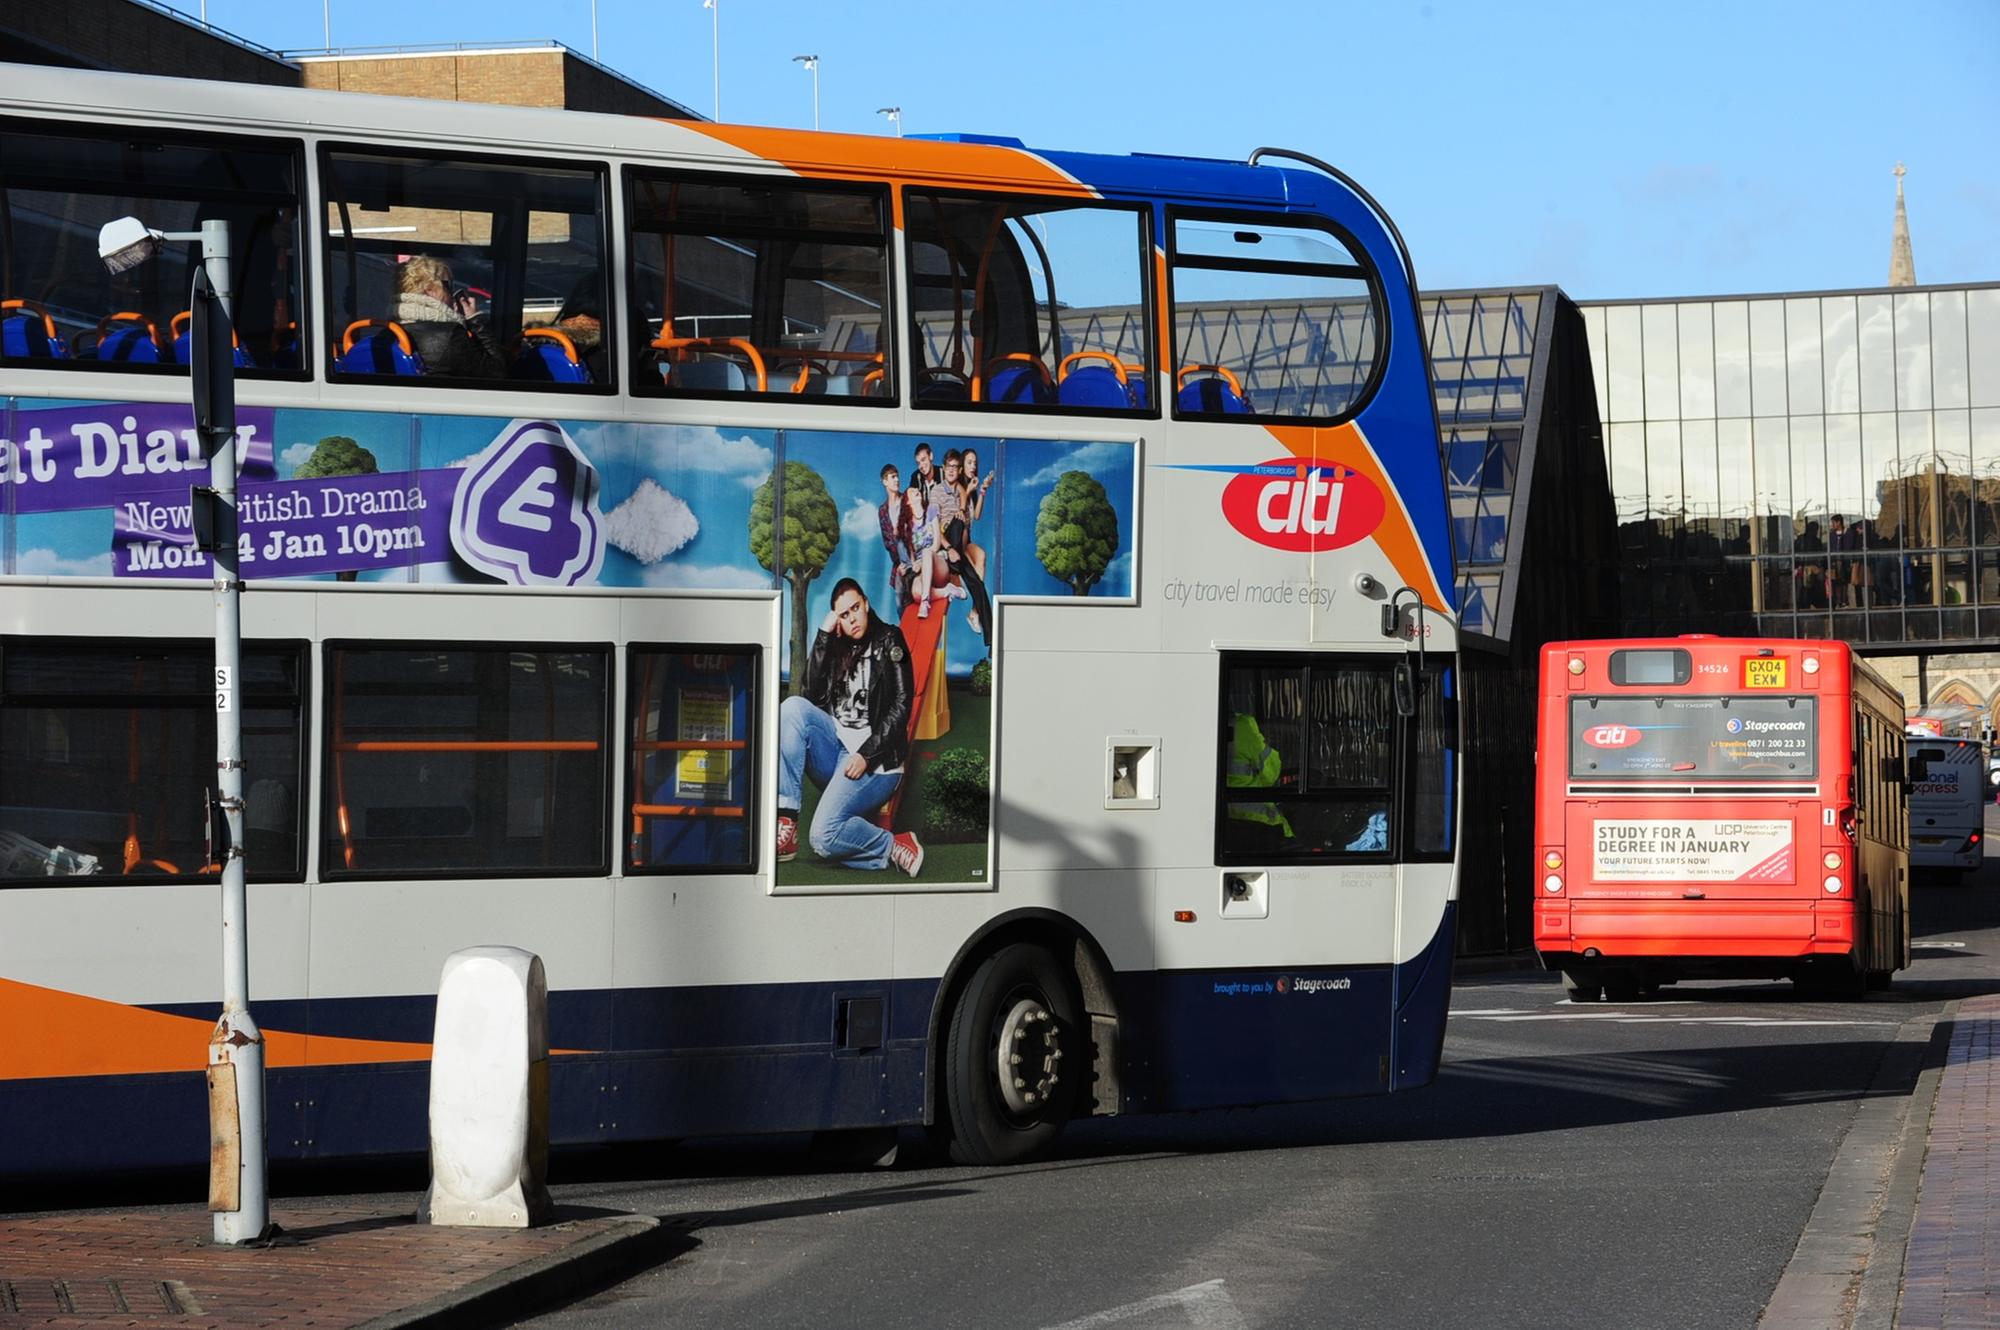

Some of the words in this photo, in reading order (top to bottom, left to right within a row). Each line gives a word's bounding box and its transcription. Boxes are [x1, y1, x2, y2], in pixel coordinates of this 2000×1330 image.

[1257, 464, 1345, 534] citi
[124, 500, 192, 532] New
[320, 486, 428, 518] Drama
[127, 540, 206, 572] Mon
[263, 530, 327, 561] Jan
[336, 523, 426, 555] 10pm
[1164, 577, 1192, 608] city
[1195, 578, 1241, 602] travel
[1245, 580, 1293, 604] made
[1298, 585, 1337, 612] easy
[1404, 623, 1431, 638] 1963
[1698, 664, 1729, 674] 34526
[1749, 661, 1781, 672] GX04
[217, 670, 226, 685] S
[1753, 674, 1777, 685] EXW
[217, 693, 226, 708] 2
[1744, 720, 1806, 733] Stagecoach
[1595, 725, 1626, 744] citi
[1768, 739, 1782, 748] 200
[1784, 739, 1794, 748] 22
[1796, 739, 1806, 748] 33
[1912, 783, 1959, 796] xpress
[1598, 826, 1648, 839] STUDY
[1652, 826, 1681, 839] FOR
[1685, 826, 1696, 839] A
[1714, 824, 1742, 836] UCP
[1598, 840, 1656, 853] DEGREE
[1660, 840, 1677, 853] IN
[1680, 840, 1750, 853] JANUARY
[1598, 857, 1621, 865] YOUR
[1622, 857, 1653, 865] FUTURE
[1655, 857, 1686, 865] STARTS
[1687, 857, 1711, 865] NOW!
[1214, 982, 1240, 995] brought
[1242, 982, 1250, 992] to
[1251, 984, 1264, 994] you
[1265, 981, 1274, 993] by
[1293, 977, 1351, 994] Stagecoach
